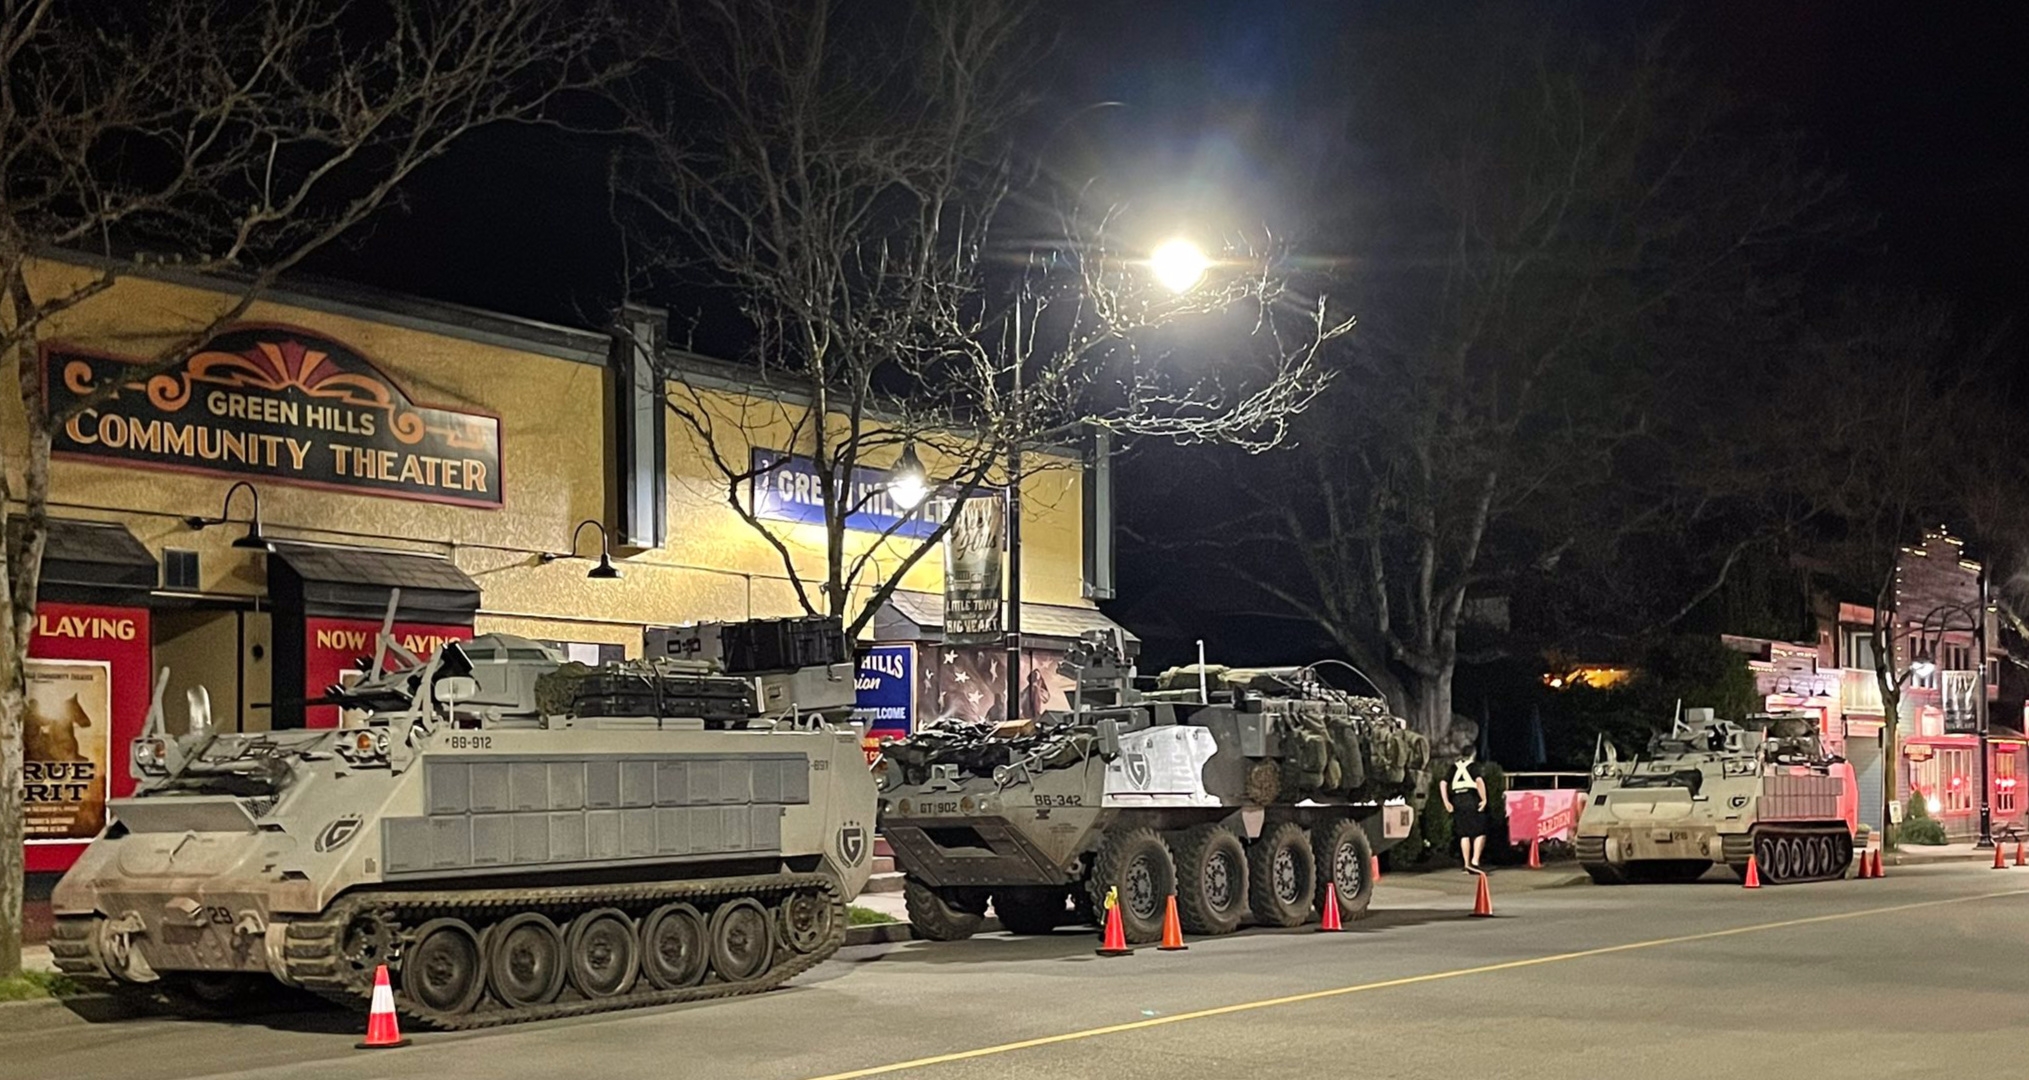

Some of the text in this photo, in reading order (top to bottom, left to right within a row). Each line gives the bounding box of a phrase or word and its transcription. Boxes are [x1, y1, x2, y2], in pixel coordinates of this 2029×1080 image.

[207, 390, 375, 436] GREEN HILLS
[65, 408, 488, 492] COMMUNITY THEATER
[778, 470, 853, 511] GREN
[33, 614, 136, 640] LAYING
[946, 620, 963, 633] BIG
[317, 629, 366, 650] NOW
[861, 655, 904, 679] HILLS
[451, 736, 492, 749] 89-912
[24, 762, 95, 780] RUE
[810, 760, 829, 771] -891
[23, 784, 88, 802] RIT
[937, 802, 957, 813] 902
[207, 906, 233, 924] 29
